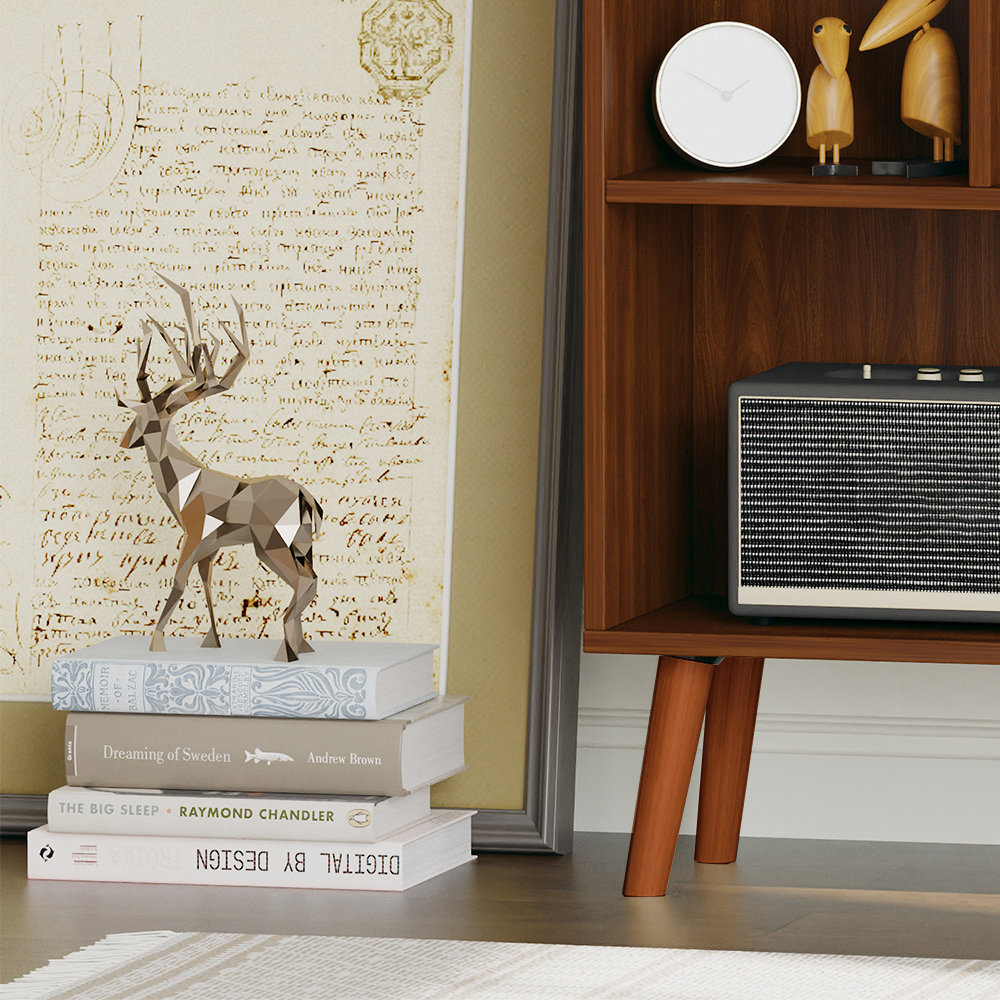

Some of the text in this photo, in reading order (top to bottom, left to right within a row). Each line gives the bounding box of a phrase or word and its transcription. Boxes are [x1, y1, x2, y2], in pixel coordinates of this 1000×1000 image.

[99, 665, 111, 710] MEMOIR
[103, 744, 231, 764] Dreaming of Sweden
[307, 752, 382, 766] Andrew Brown
[58, 801, 159, 817] THE BIG SLEEP
[179, 805, 335, 822] RAYMOND CHANDLER
[195, 848, 401, 875] DIGITAL BY DESIGN
